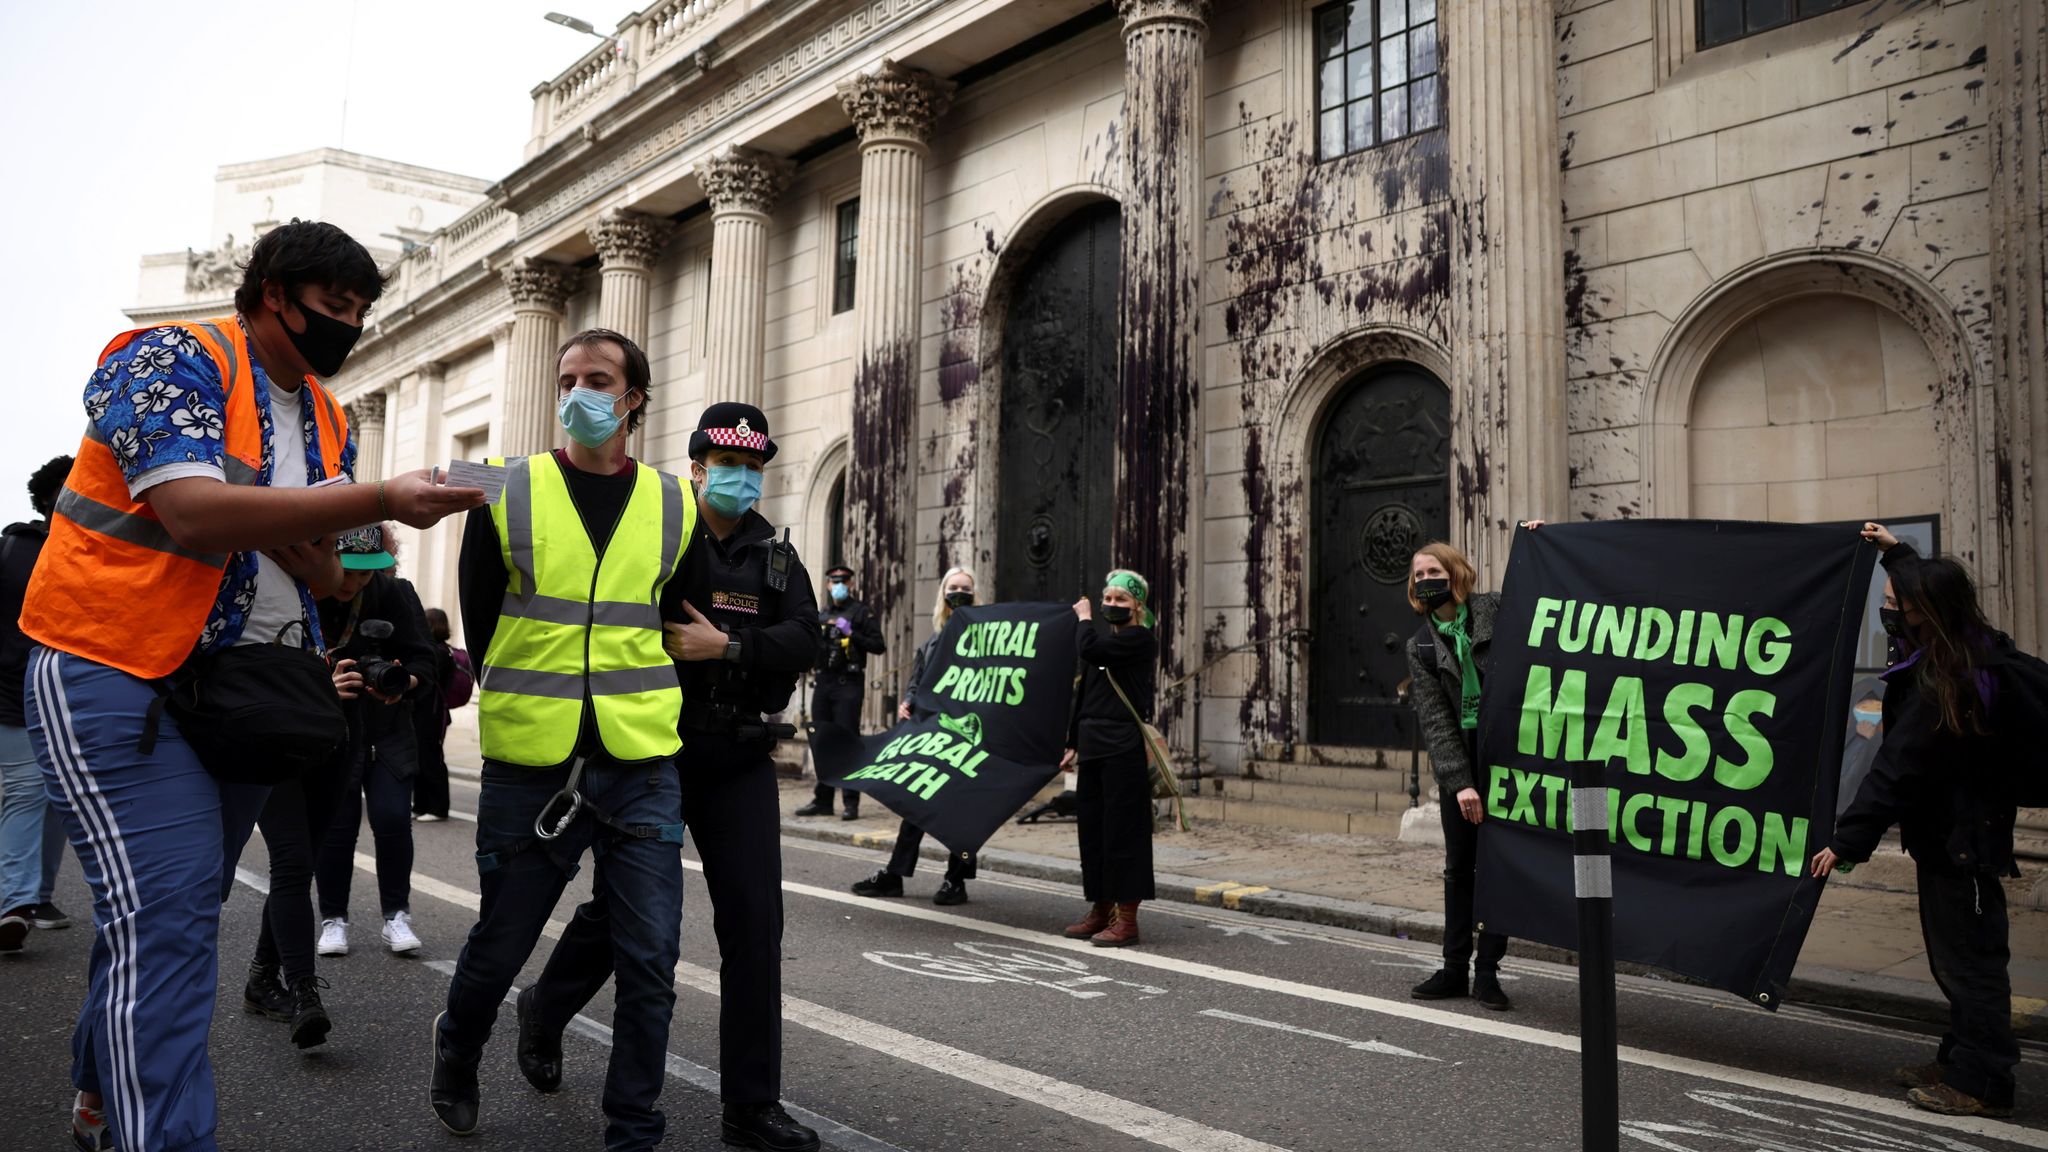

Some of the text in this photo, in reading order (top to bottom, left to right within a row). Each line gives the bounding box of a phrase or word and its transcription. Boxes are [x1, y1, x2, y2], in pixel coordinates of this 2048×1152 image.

[728, 597, 759, 609] POLICE
[956, 621, 1039, 659] CENTRAL
[1528, 597, 1792, 675] FUNDING
[933, 665, 1027, 706] PROFITS
[1518, 665, 1777, 790] MASS
[875, 732, 989, 778] GLOBAL
[843, 761, 950, 800] DEATH
